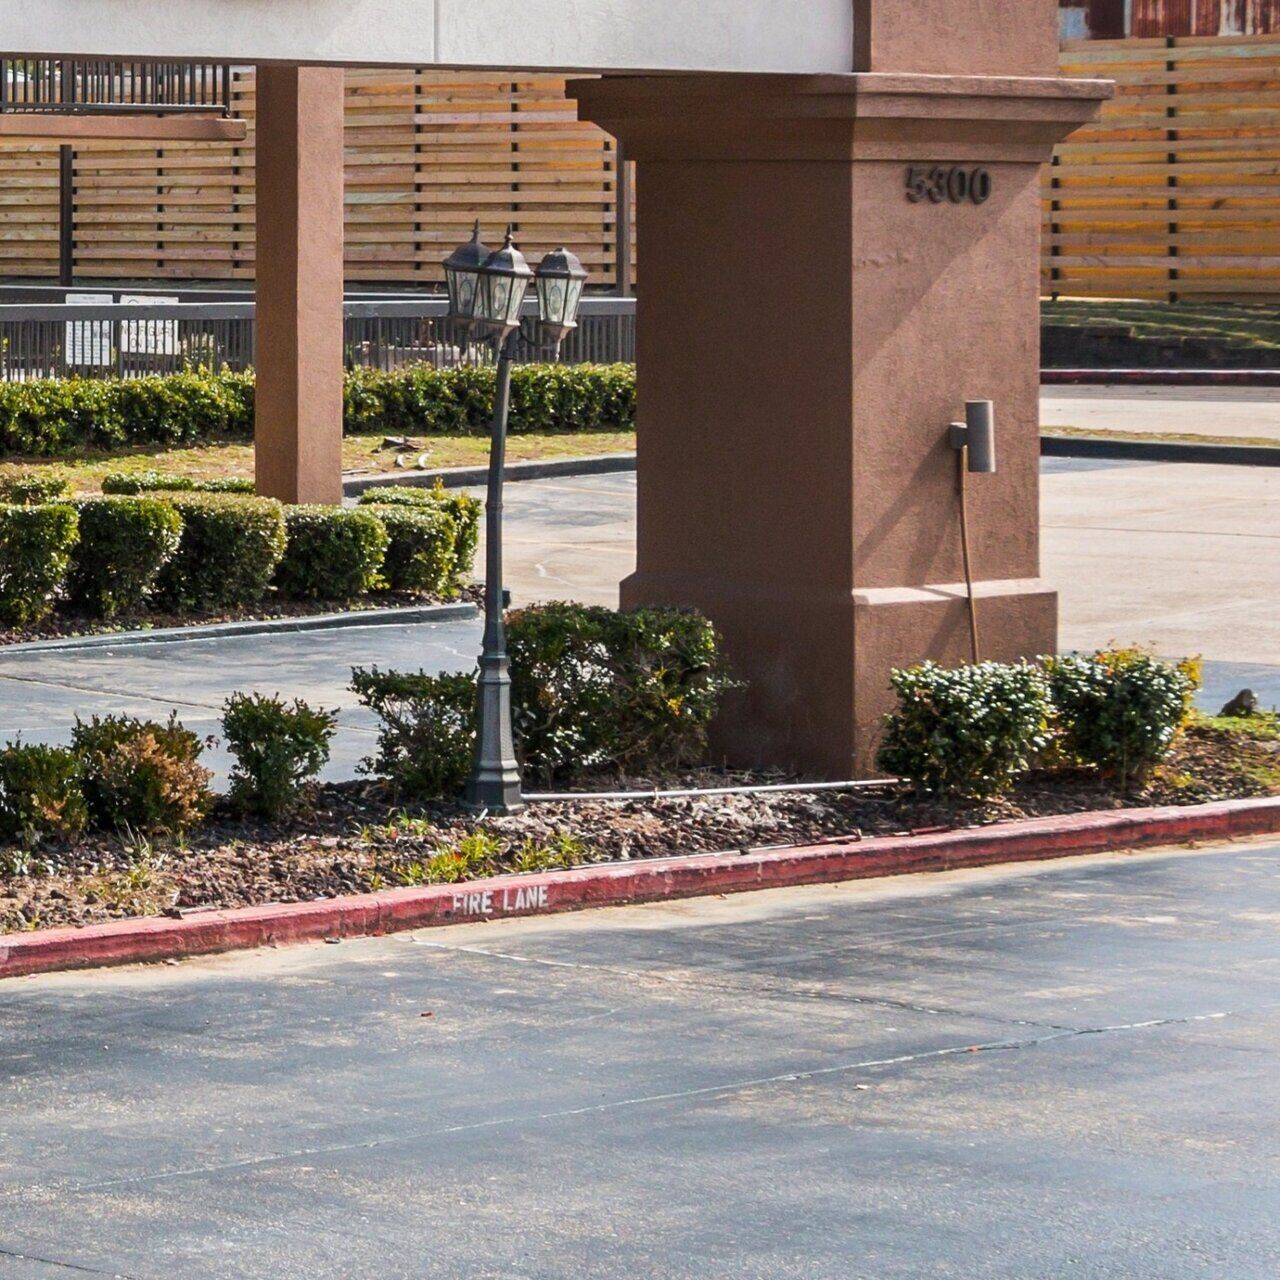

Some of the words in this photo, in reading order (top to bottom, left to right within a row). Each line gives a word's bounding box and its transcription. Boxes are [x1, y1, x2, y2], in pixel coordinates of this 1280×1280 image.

[905, 165, 992, 205] 5300
[452, 891, 494, 915] FIRE
[503, 886, 549, 911] LANE
